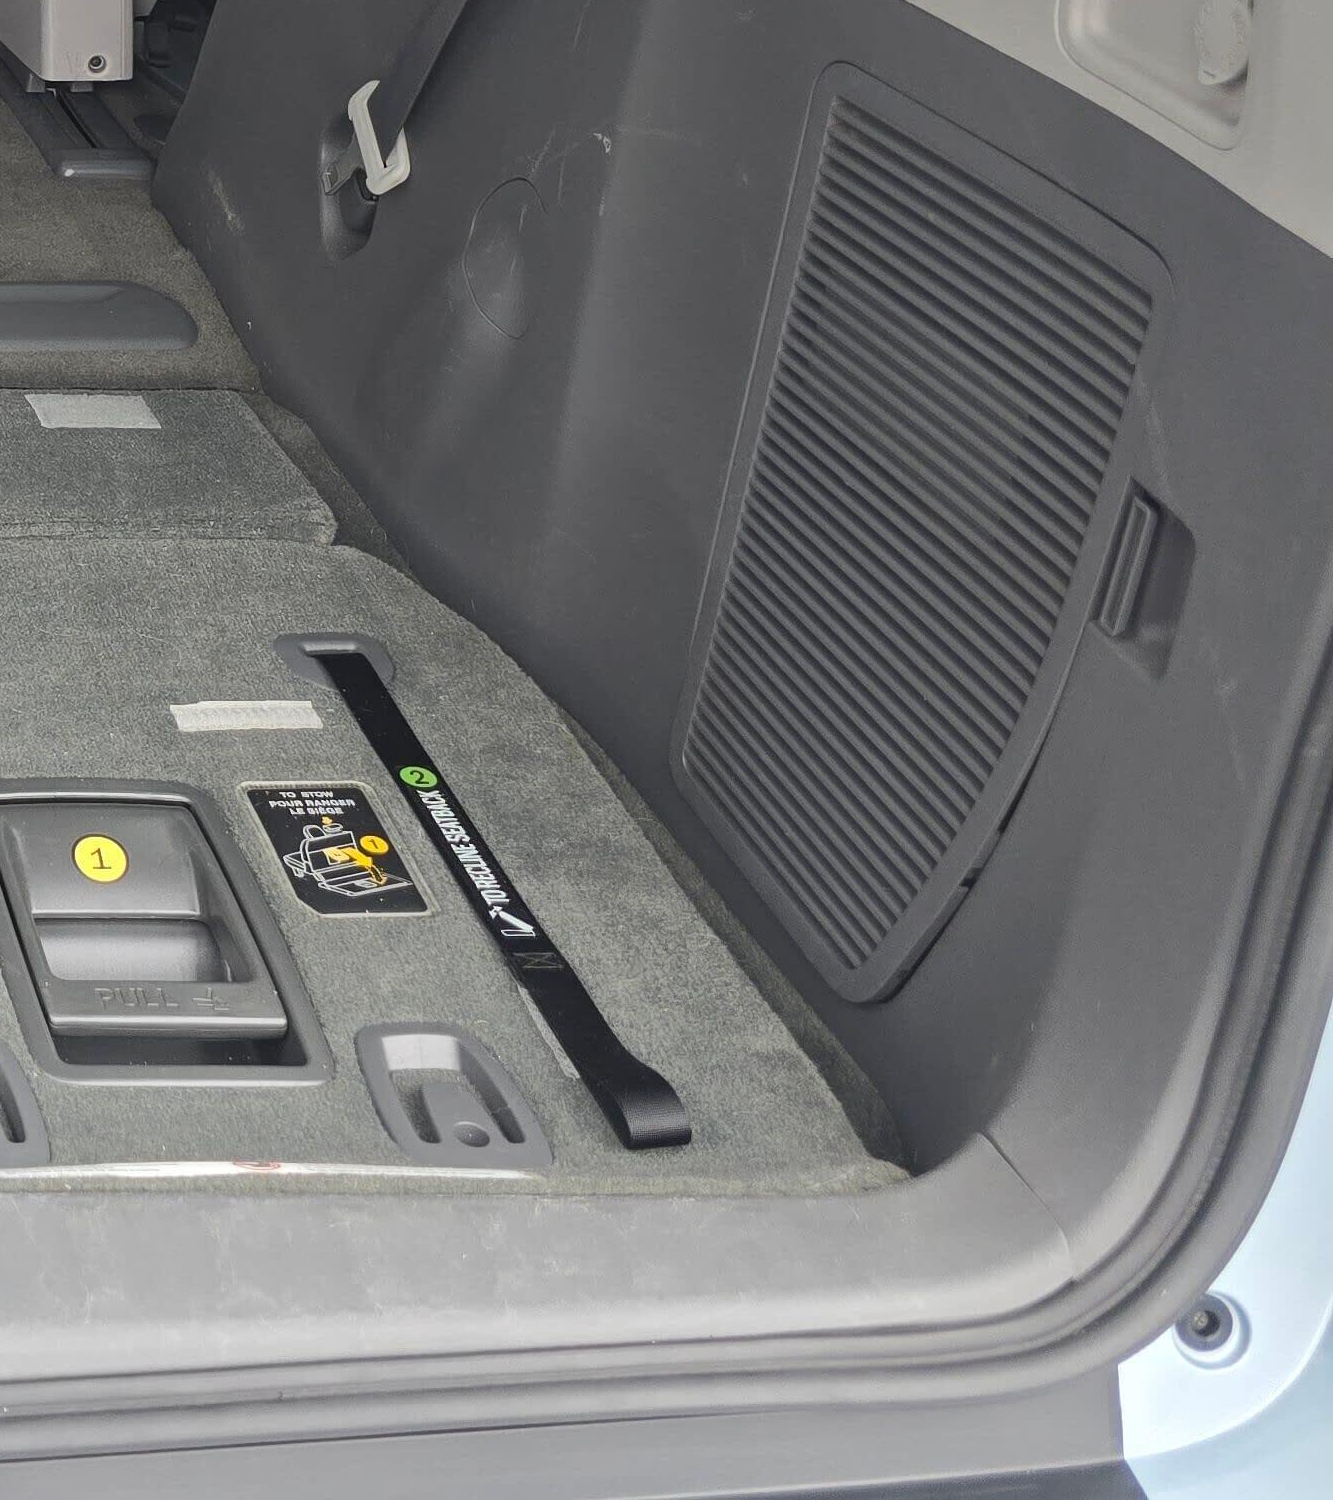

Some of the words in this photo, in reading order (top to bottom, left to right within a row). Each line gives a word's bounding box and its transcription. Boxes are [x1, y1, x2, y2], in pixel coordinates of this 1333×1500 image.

[409, 770, 430, 785] 2
[269, 800, 304, 808] POUR
[304, 799, 356, 807] RANGER
[289, 807, 306, 815] LE
[416, 789, 470, 844] SEATBACK
[90, 847, 112, 870] 1
[451, 843, 501, 889] RECLINE
[481, 889, 509, 907] TO
[94, 987, 179, 1010] PULL
